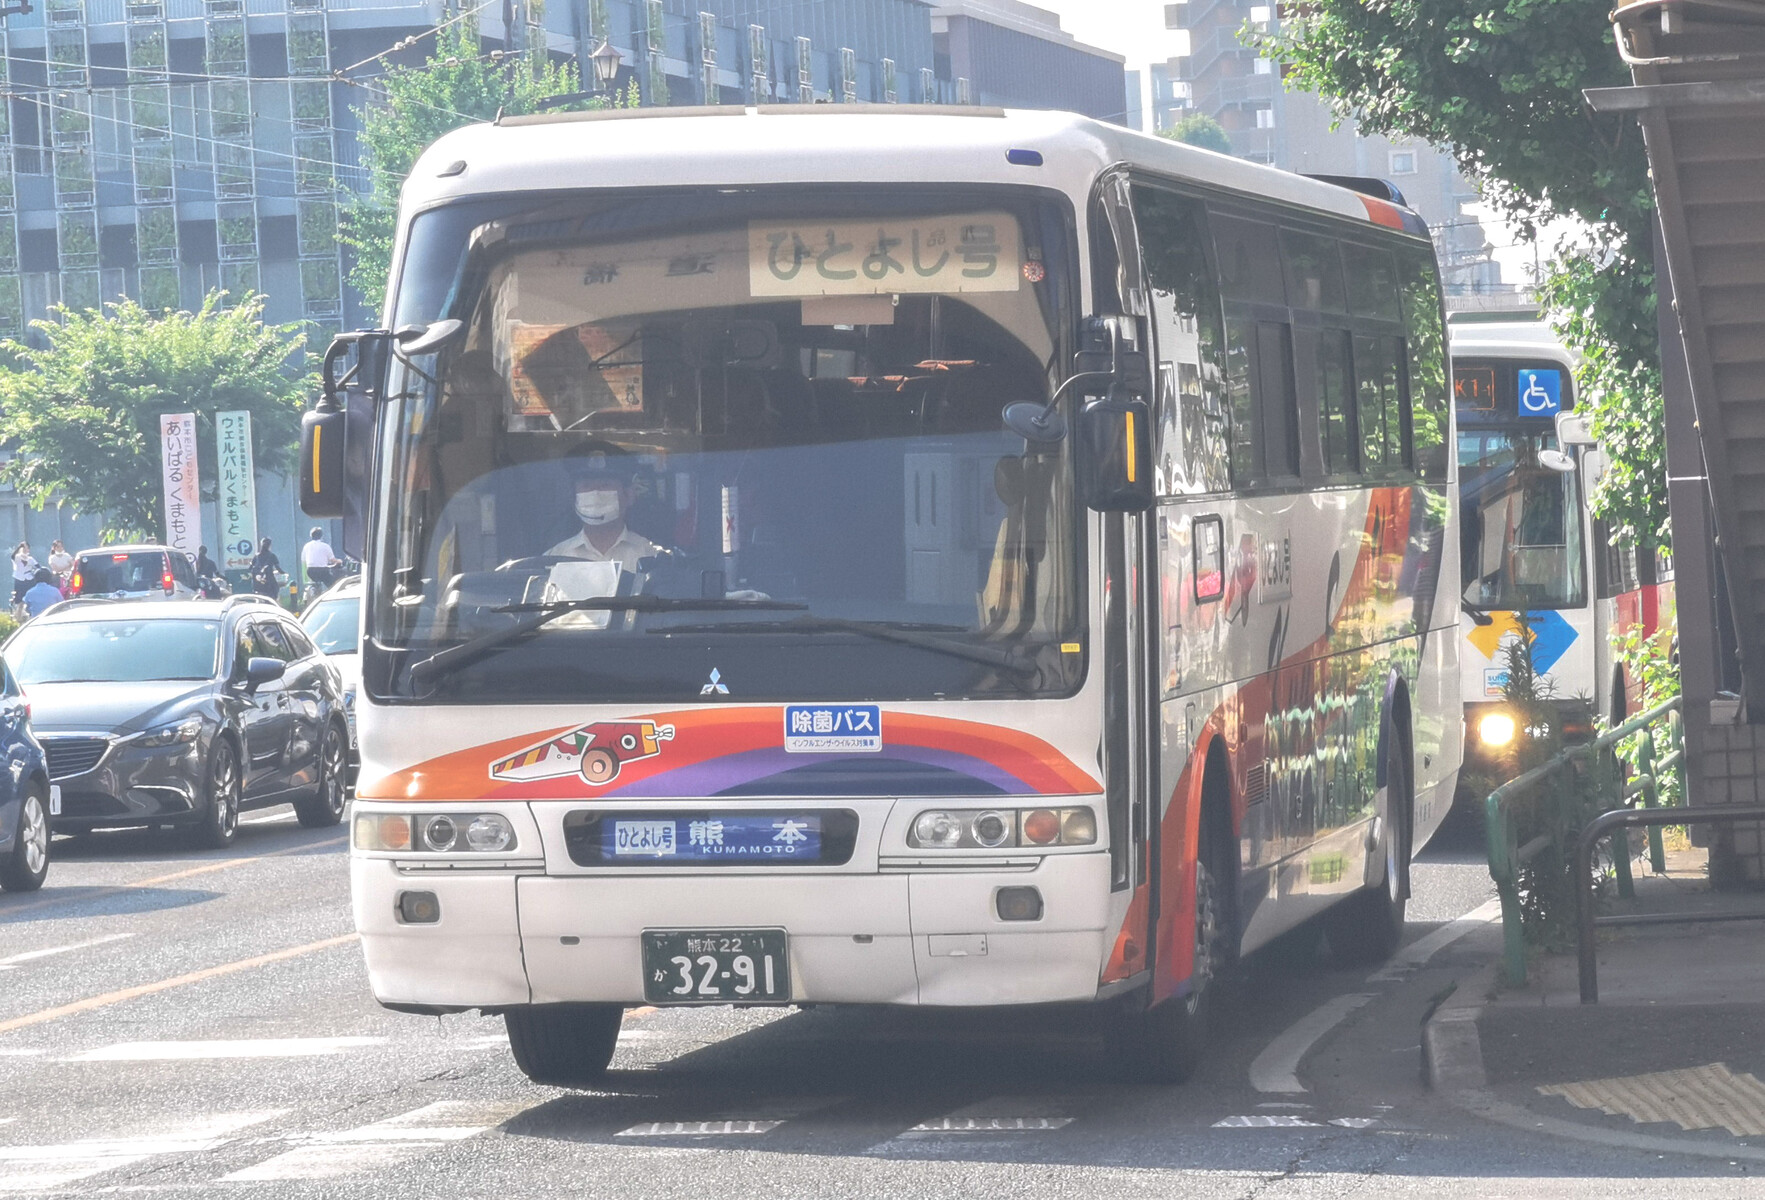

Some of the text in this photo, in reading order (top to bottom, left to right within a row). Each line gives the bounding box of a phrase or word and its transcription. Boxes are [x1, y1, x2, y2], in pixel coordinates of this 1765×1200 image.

[792, 709, 874, 733] 除菌バス
[618, 826, 673, 849] ひとよし号
[689, 820, 808, 845] 熊本
[702, 845, 796, 854] KUMAMOTO
[654, 955, 774, 994] か 32-91
